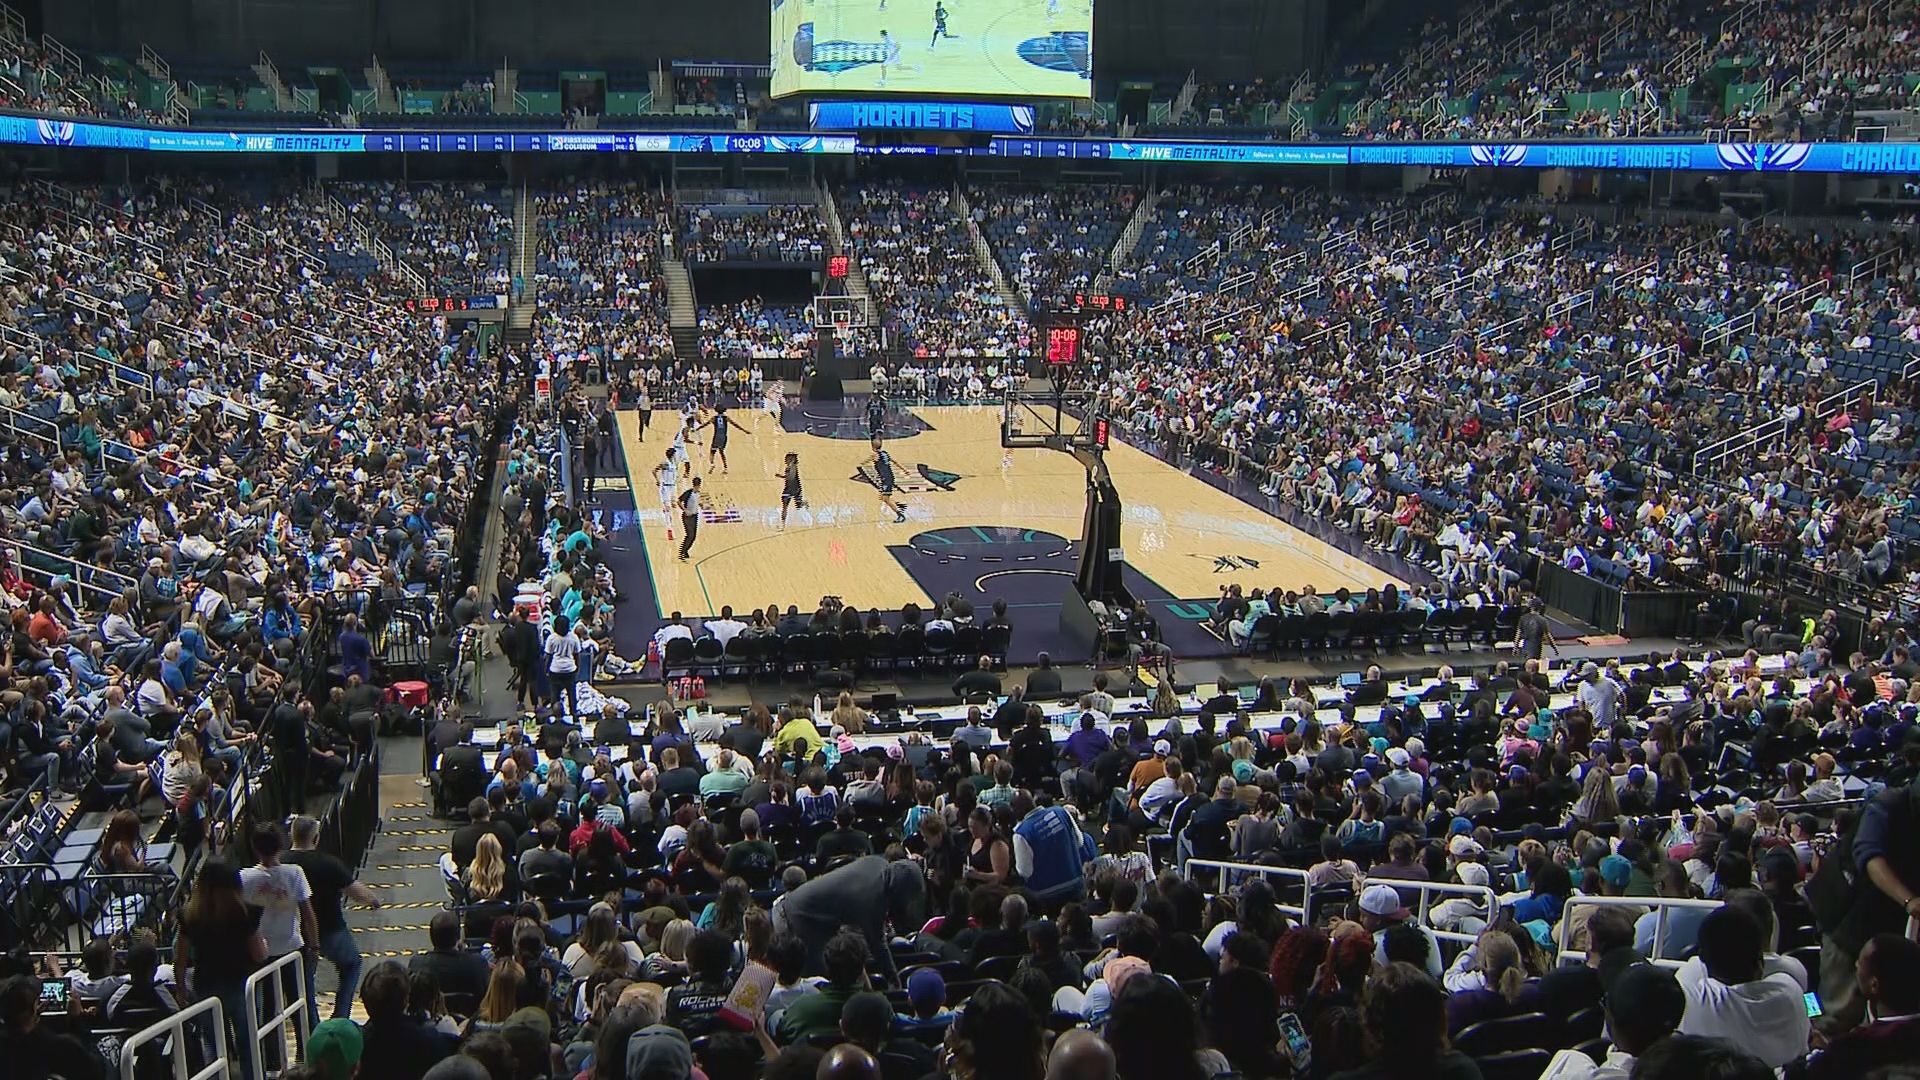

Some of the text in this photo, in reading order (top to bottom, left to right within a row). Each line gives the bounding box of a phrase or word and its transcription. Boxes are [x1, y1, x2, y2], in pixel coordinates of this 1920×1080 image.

[853, 104, 974, 129] HORNETS
[246, 136, 351, 150] HIVE MENTALITY
[564, 143, 597, 151] COLISEUM
[647, 139, 660, 149] 65
[732, 138, 761, 149] 10:08
[832, 140, 845, 150] 74
[1141, 148, 1173, 159] HIVE
[1173, 148, 1246, 160] MENTALITY
[1359, 147, 1407, 164] CHARLOTTE
[1411, 147, 1454, 165] HORNETS
[1546, 147, 1691, 169] CHARLOTTE HORNETS
[1051, 329, 1077, 341] 10:08
